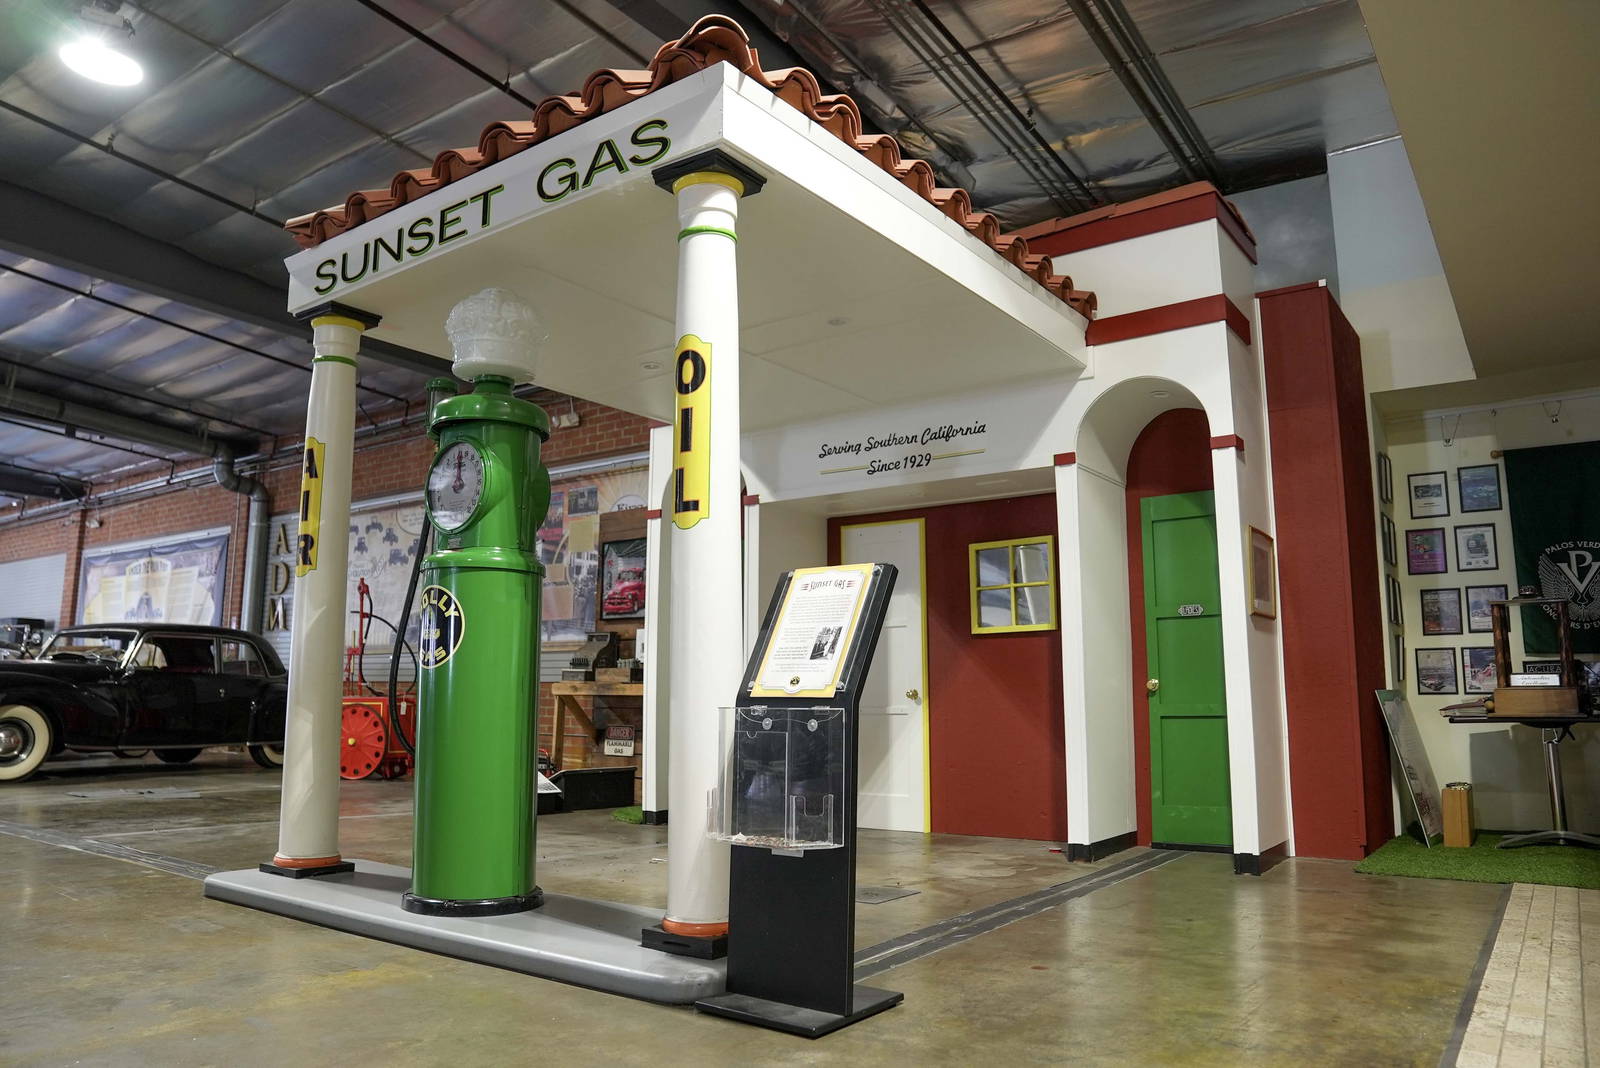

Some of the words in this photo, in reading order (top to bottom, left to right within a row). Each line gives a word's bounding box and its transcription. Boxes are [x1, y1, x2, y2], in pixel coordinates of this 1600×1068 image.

[314, 184, 504, 296] SUNSET
[537, 118, 672, 203] GAS
[675, 349, 706, 514] OIL
[819, 441, 862, 459] Serving
[864, 433, 918, 452] Southern
[920, 421, 986, 446] California
[867, 459, 901, 475] Since
[903, 453, 932, 469] 1929
[297, 447, 318, 566] AIR
[1545, 541, 1575, 555] PALOS
[420, 590, 460, 618] OLLY
